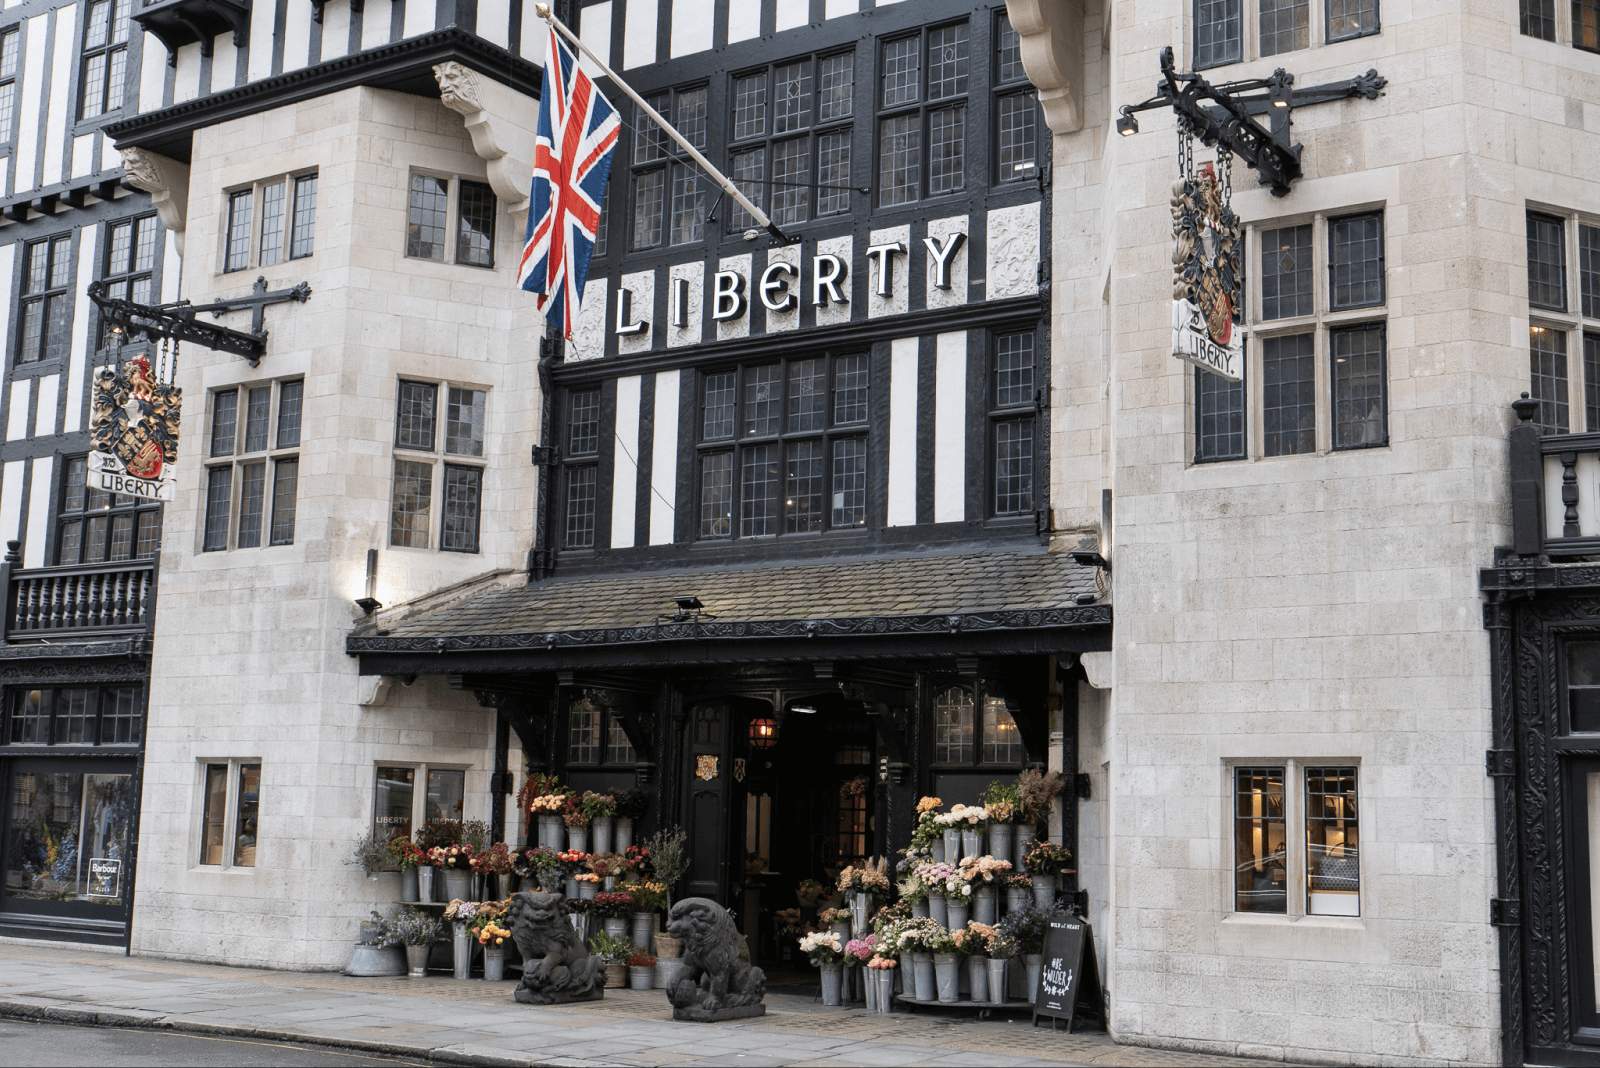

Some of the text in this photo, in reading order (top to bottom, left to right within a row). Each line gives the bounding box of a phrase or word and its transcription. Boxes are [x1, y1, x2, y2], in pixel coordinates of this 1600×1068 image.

[615, 232, 968, 336] LIBERTY
[376, 816, 409, 824] LIBERTY
[92, 863, 118, 874] Barbour
[1051, 957, 1063, 971] #BE
[1047, 968, 1066, 986] WILDER
